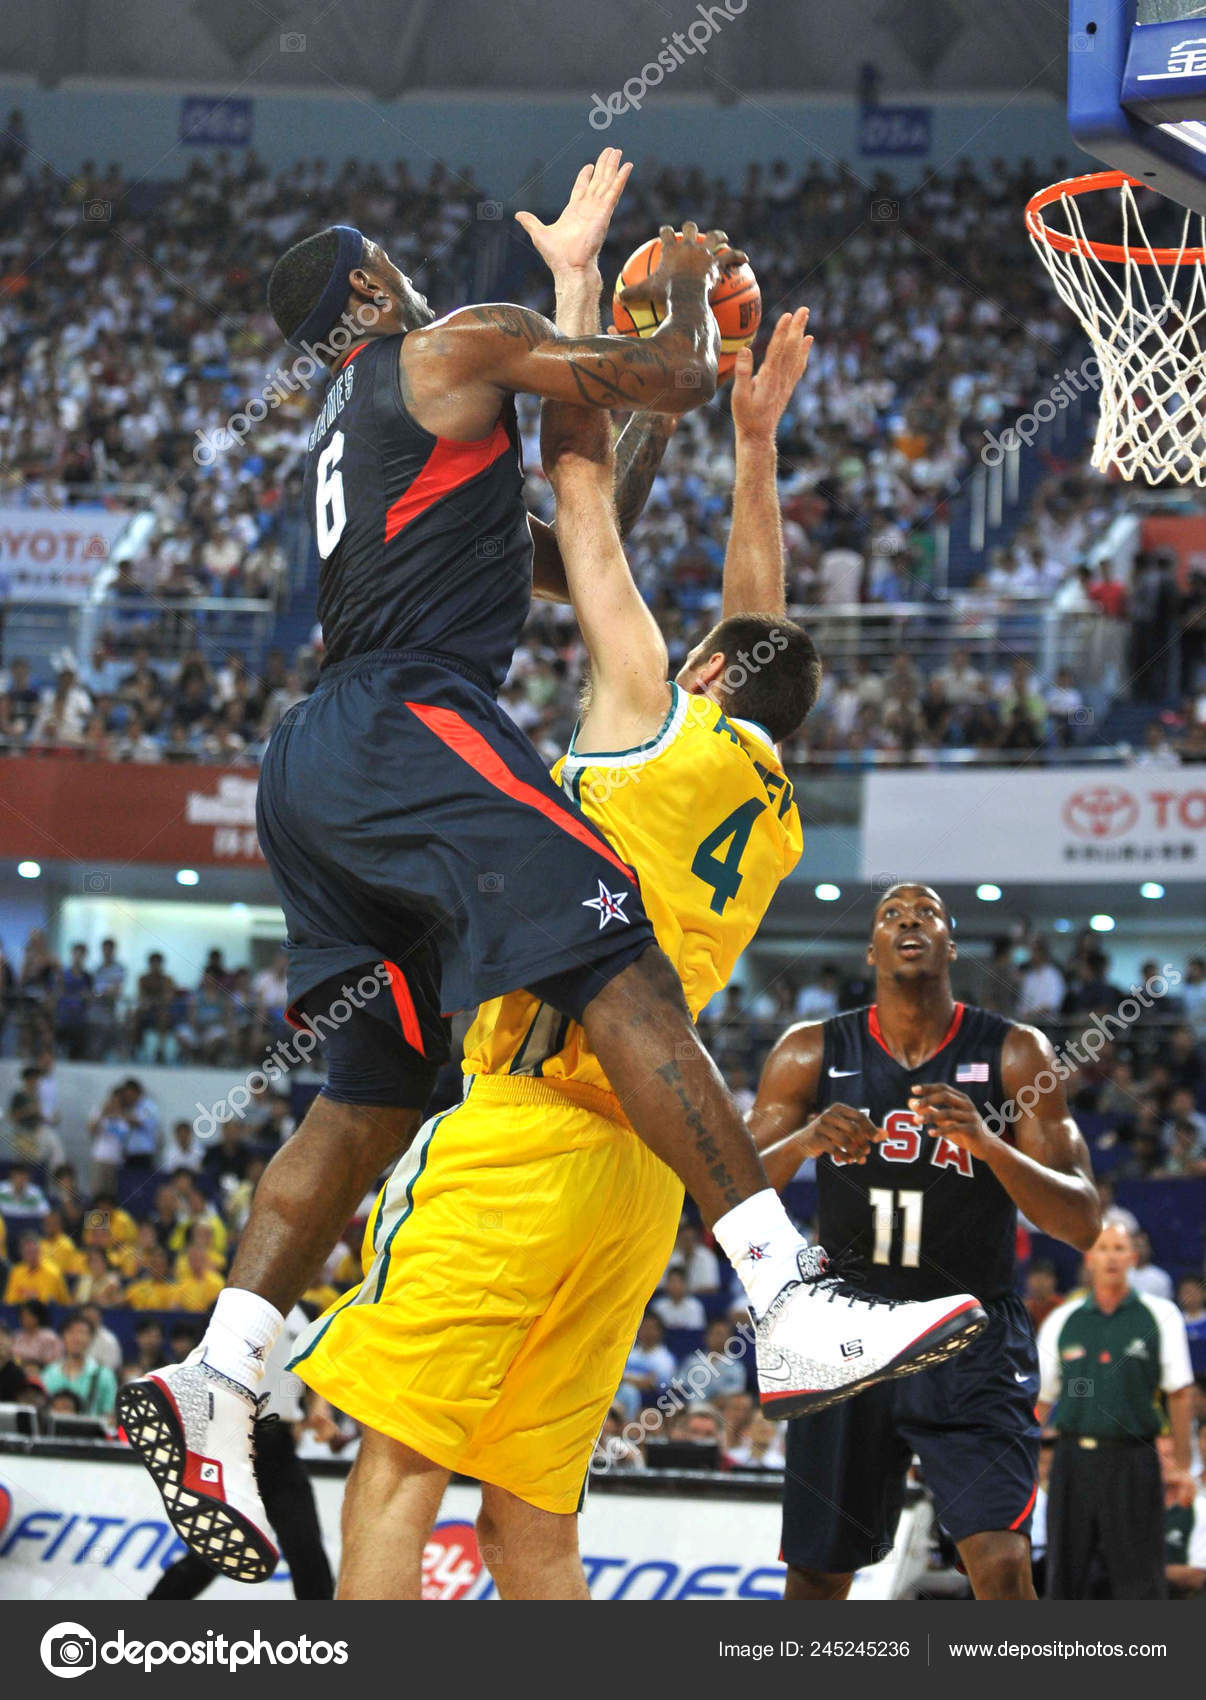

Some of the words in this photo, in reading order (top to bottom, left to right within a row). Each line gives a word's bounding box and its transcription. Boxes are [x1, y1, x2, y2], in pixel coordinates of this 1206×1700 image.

[308, 364, 355, 452] JAMES
[316, 430, 348, 560] 6
[690, 796, 768, 917] 4
[831, 1108, 974, 1178] SA
[869, 1187, 924, 1268] 11
